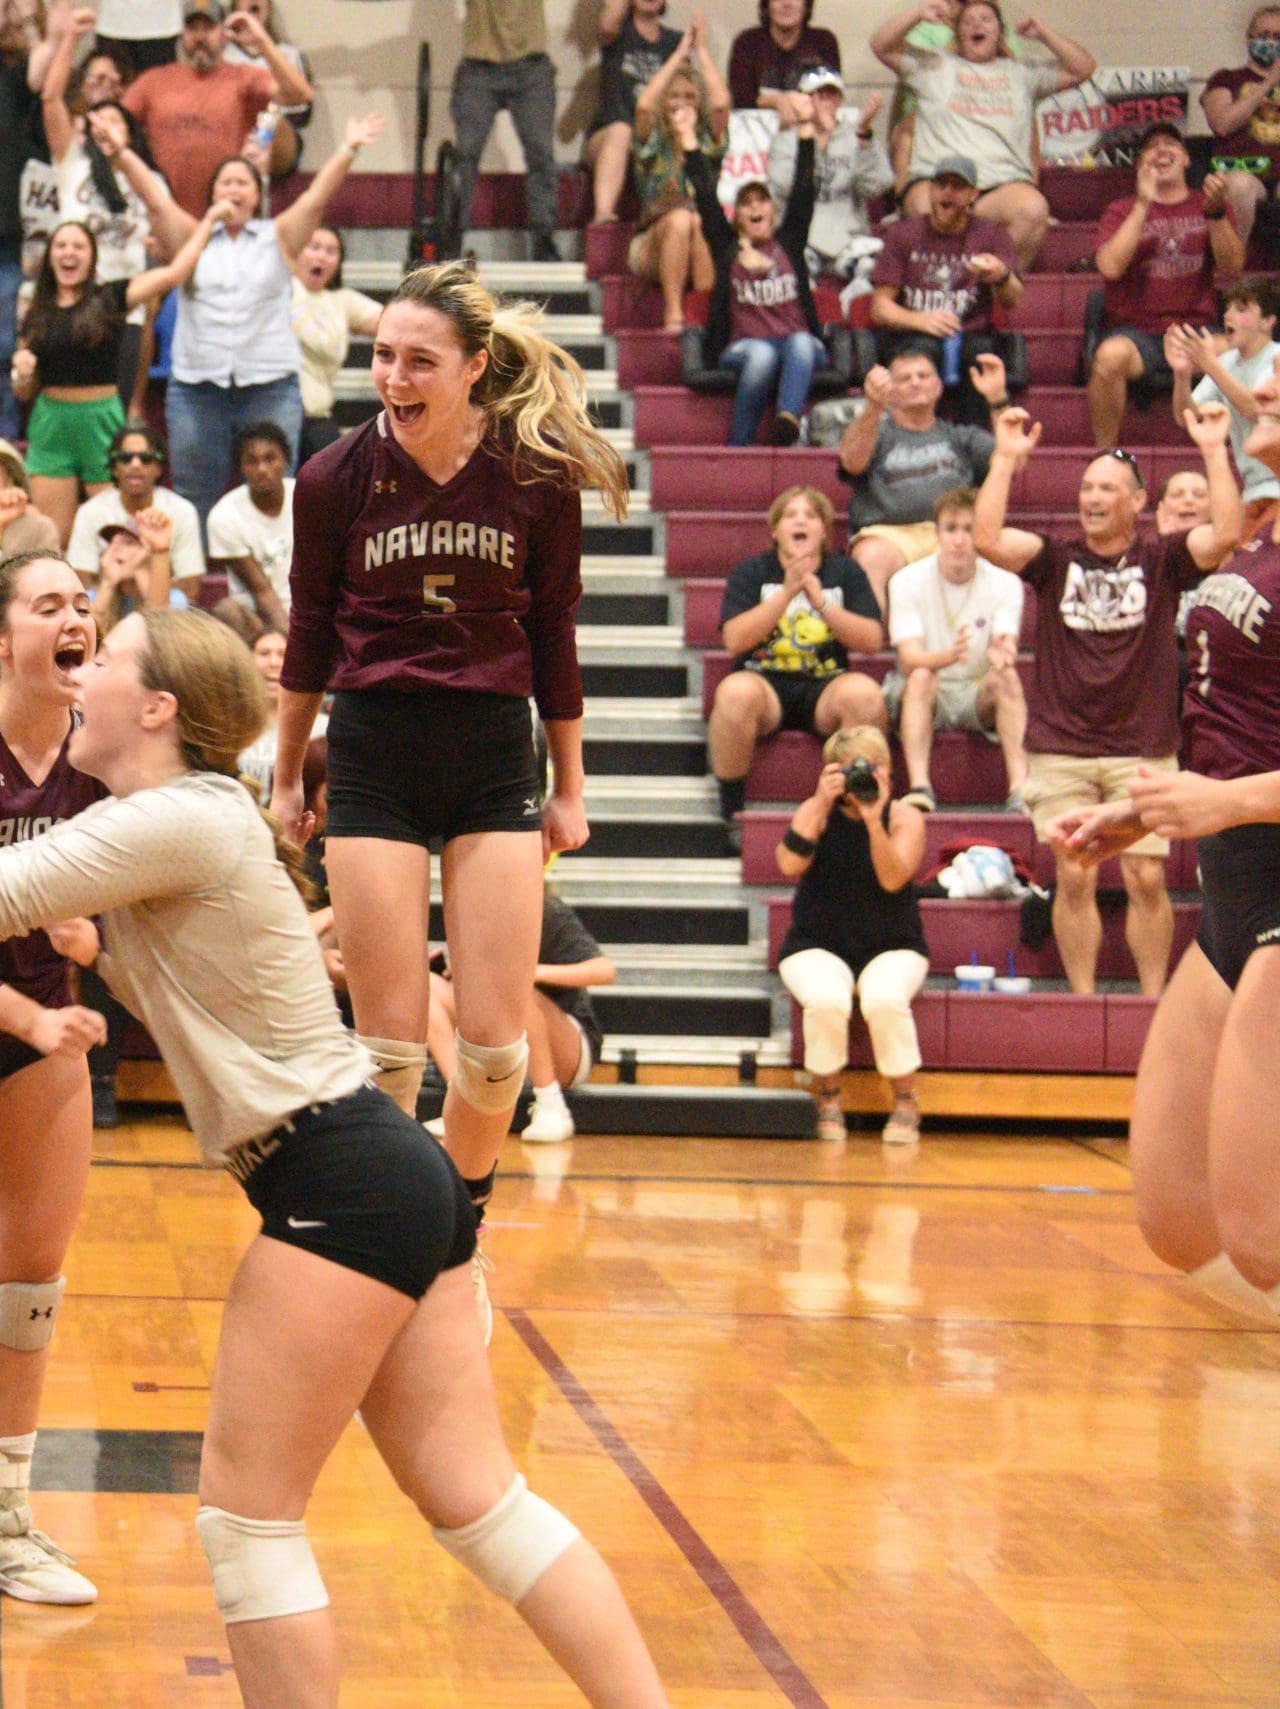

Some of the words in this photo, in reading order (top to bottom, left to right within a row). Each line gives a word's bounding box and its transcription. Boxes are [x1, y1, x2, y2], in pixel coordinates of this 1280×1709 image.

[1041, 94, 1186, 138] RAIDERS
[364, 520, 516, 572] NAVARRE
[422, 574, 457, 613] 5
